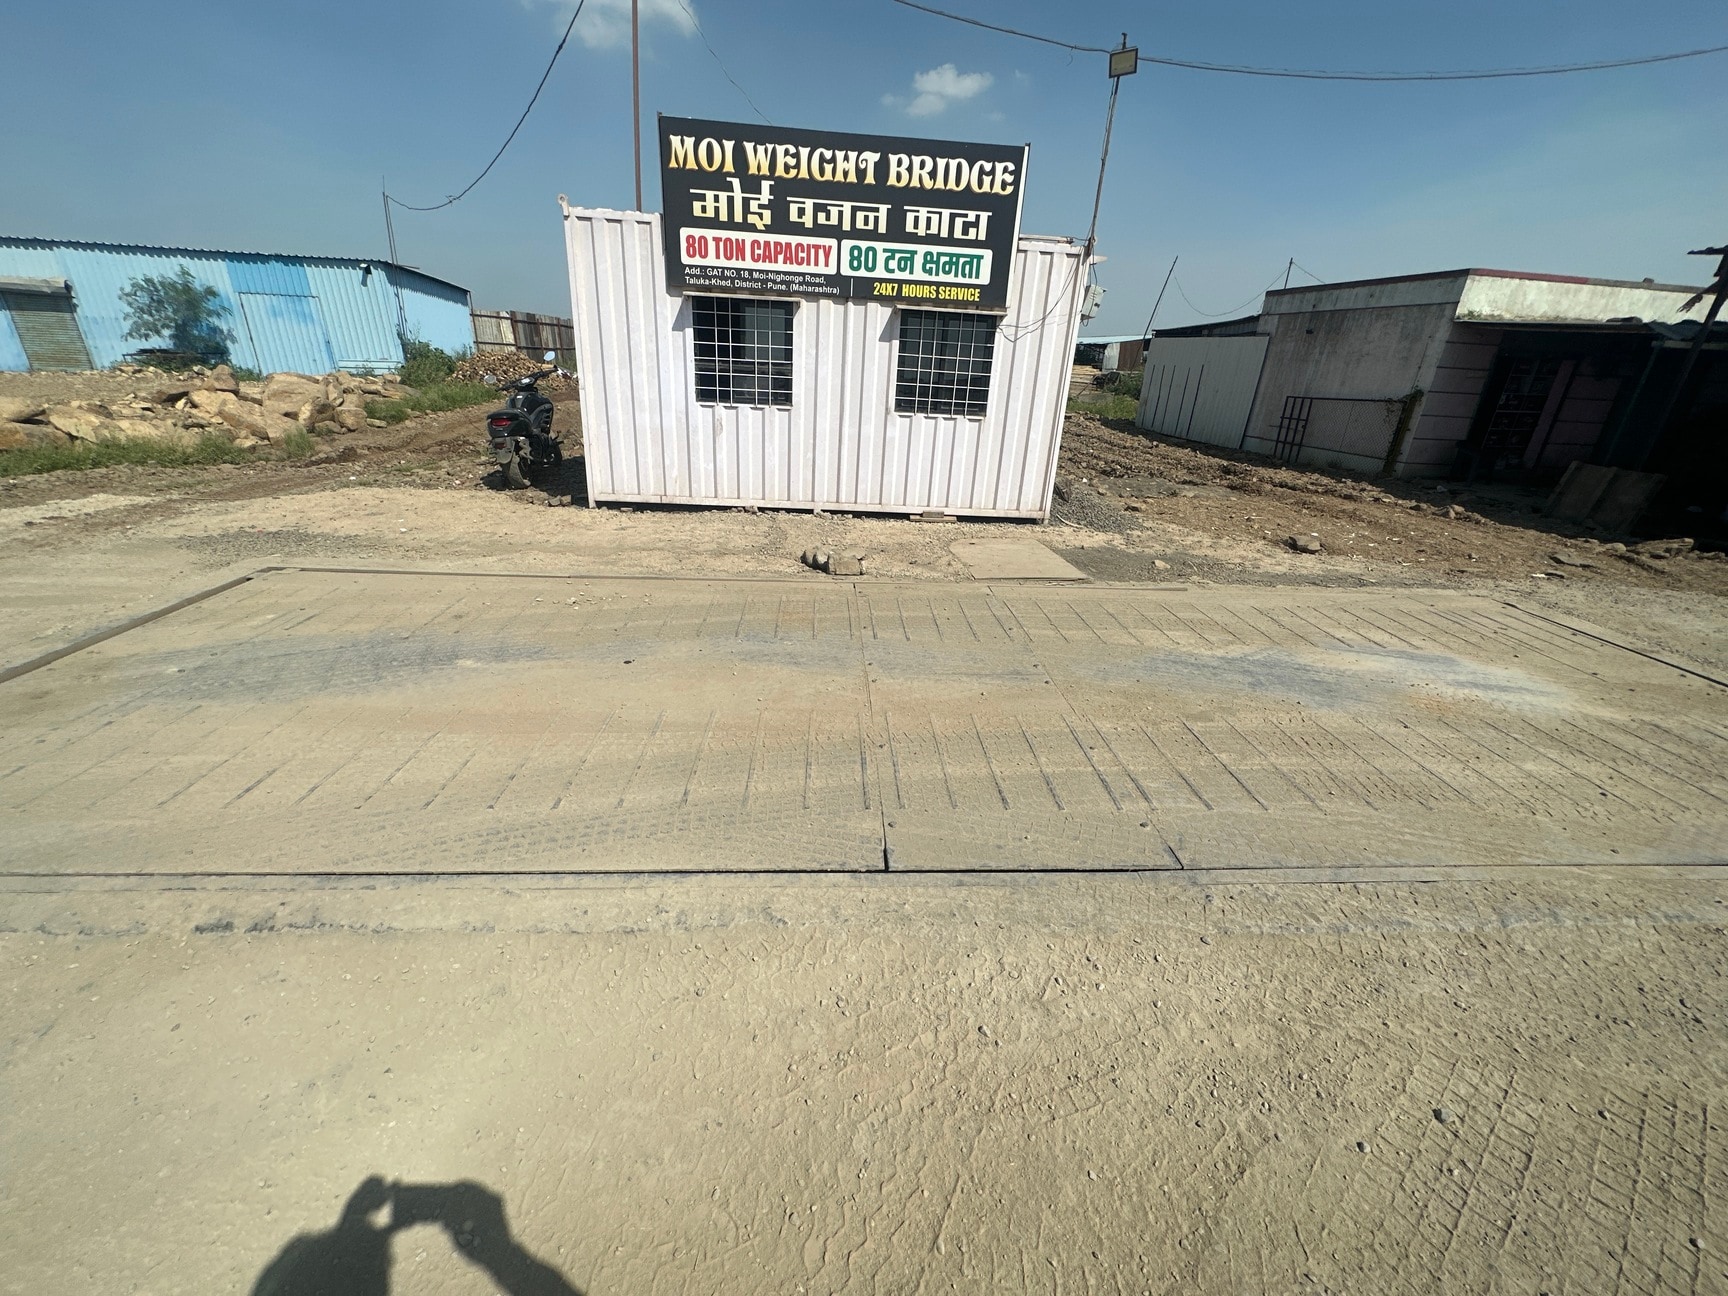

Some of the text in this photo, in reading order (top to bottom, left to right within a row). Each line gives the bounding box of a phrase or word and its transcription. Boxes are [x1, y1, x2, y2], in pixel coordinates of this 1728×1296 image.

[668, 134, 1016, 196] MOI WEIGHT BRIDGE
[690, 177, 992, 241] मोई वजन काटा
[685, 234, 833, 267] 80 TON CAPACITY
[849, 245, 984, 279] 80 टन क्षमता
[685, 276, 733, 288] Taluka-Khed,
[735, 279, 762, 289] District
[767, 282, 788, 291] Pune.
[790, 283, 840, 295] (Maharashtra)
[706, 268, 723, 276] GAT
[724, 269, 738, 278] NO.
[740, 270, 751, 279] 18,
[805, 274, 827, 285] Road,
[873, 282, 981, 301] 24X7 HOURS SERVICE
